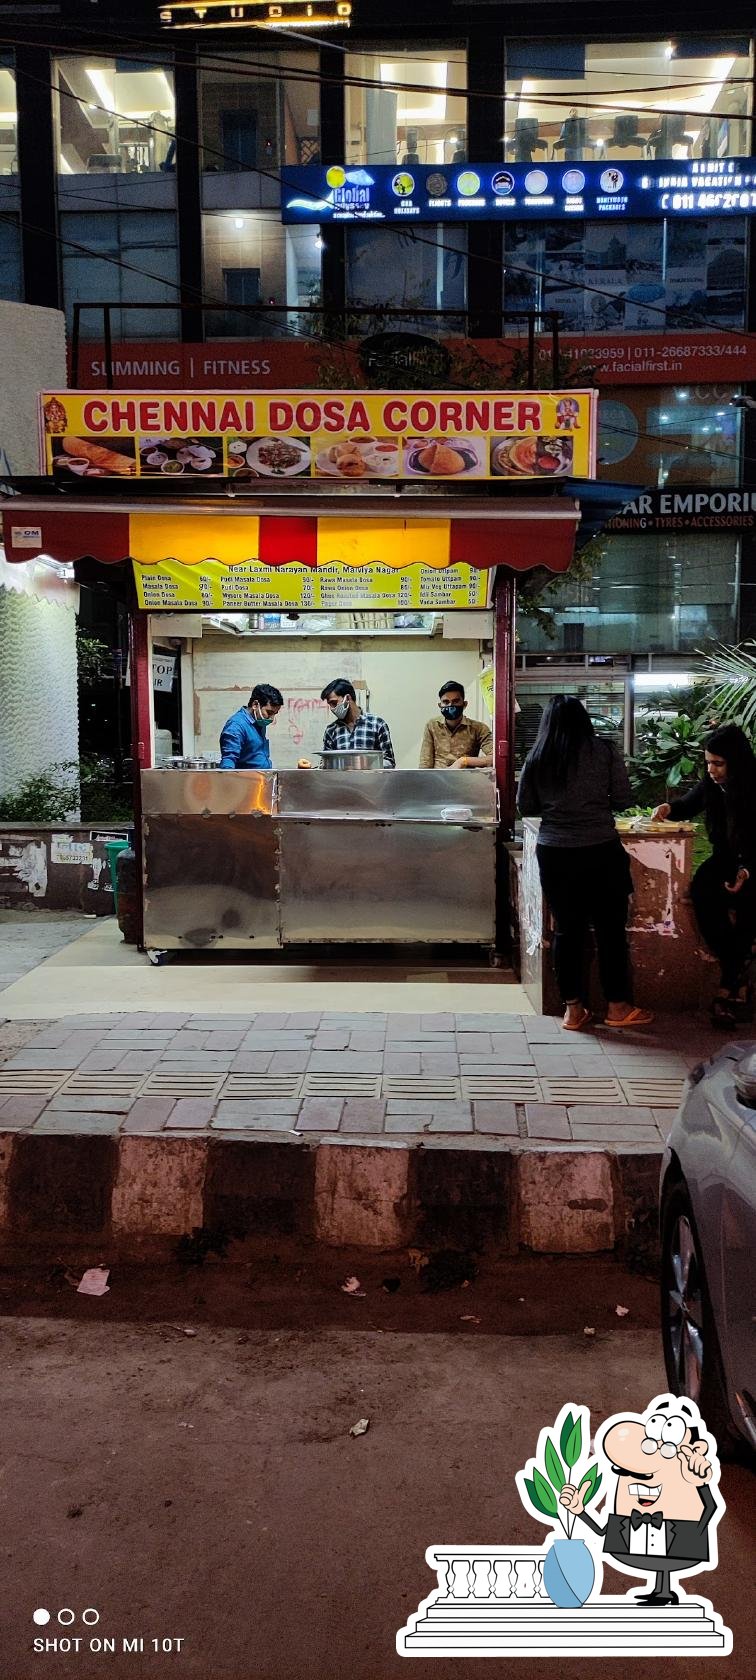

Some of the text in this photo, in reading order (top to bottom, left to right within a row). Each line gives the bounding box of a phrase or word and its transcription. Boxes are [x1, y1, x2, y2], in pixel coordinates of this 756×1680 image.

[91, 359, 271, 376] SLIMMING FITNESS
[82, 399, 542, 433] CHENNAI DOSA CORNER
[616, 494, 653, 515] AR
[655, 517, 683, 529] TYRES
[691, 515, 754, 528] ACCESSORIES
[228, 565, 247, 573] Near
[249, 565, 272, 573] Laxmi
[274, 566, 308, 574] Narayan
